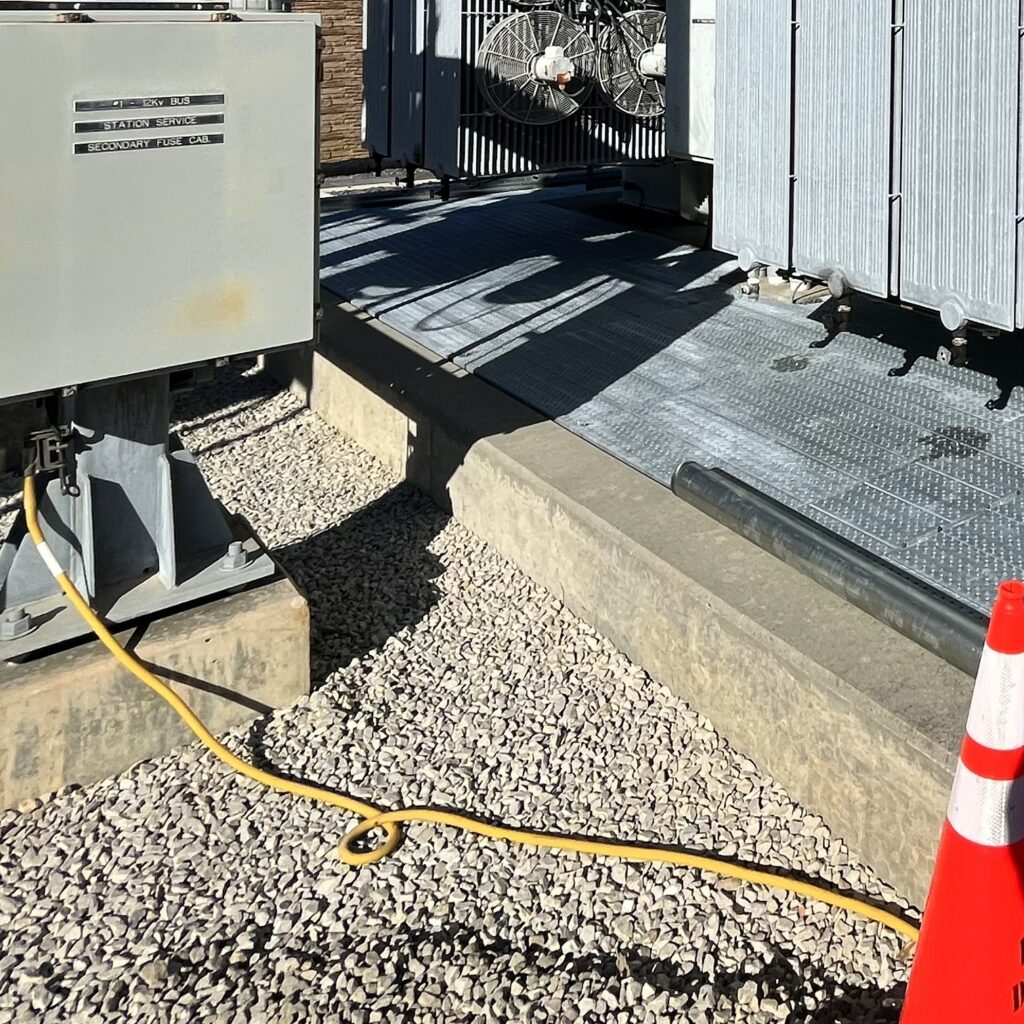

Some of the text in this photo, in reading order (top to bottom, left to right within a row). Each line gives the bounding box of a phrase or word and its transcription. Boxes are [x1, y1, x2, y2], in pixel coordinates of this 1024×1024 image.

[170, 96, 190, 106] BUS
[103, 116, 197, 130] STATION SERVICE
[87, 135, 211, 152] SECONDARY FUSE CAB.
